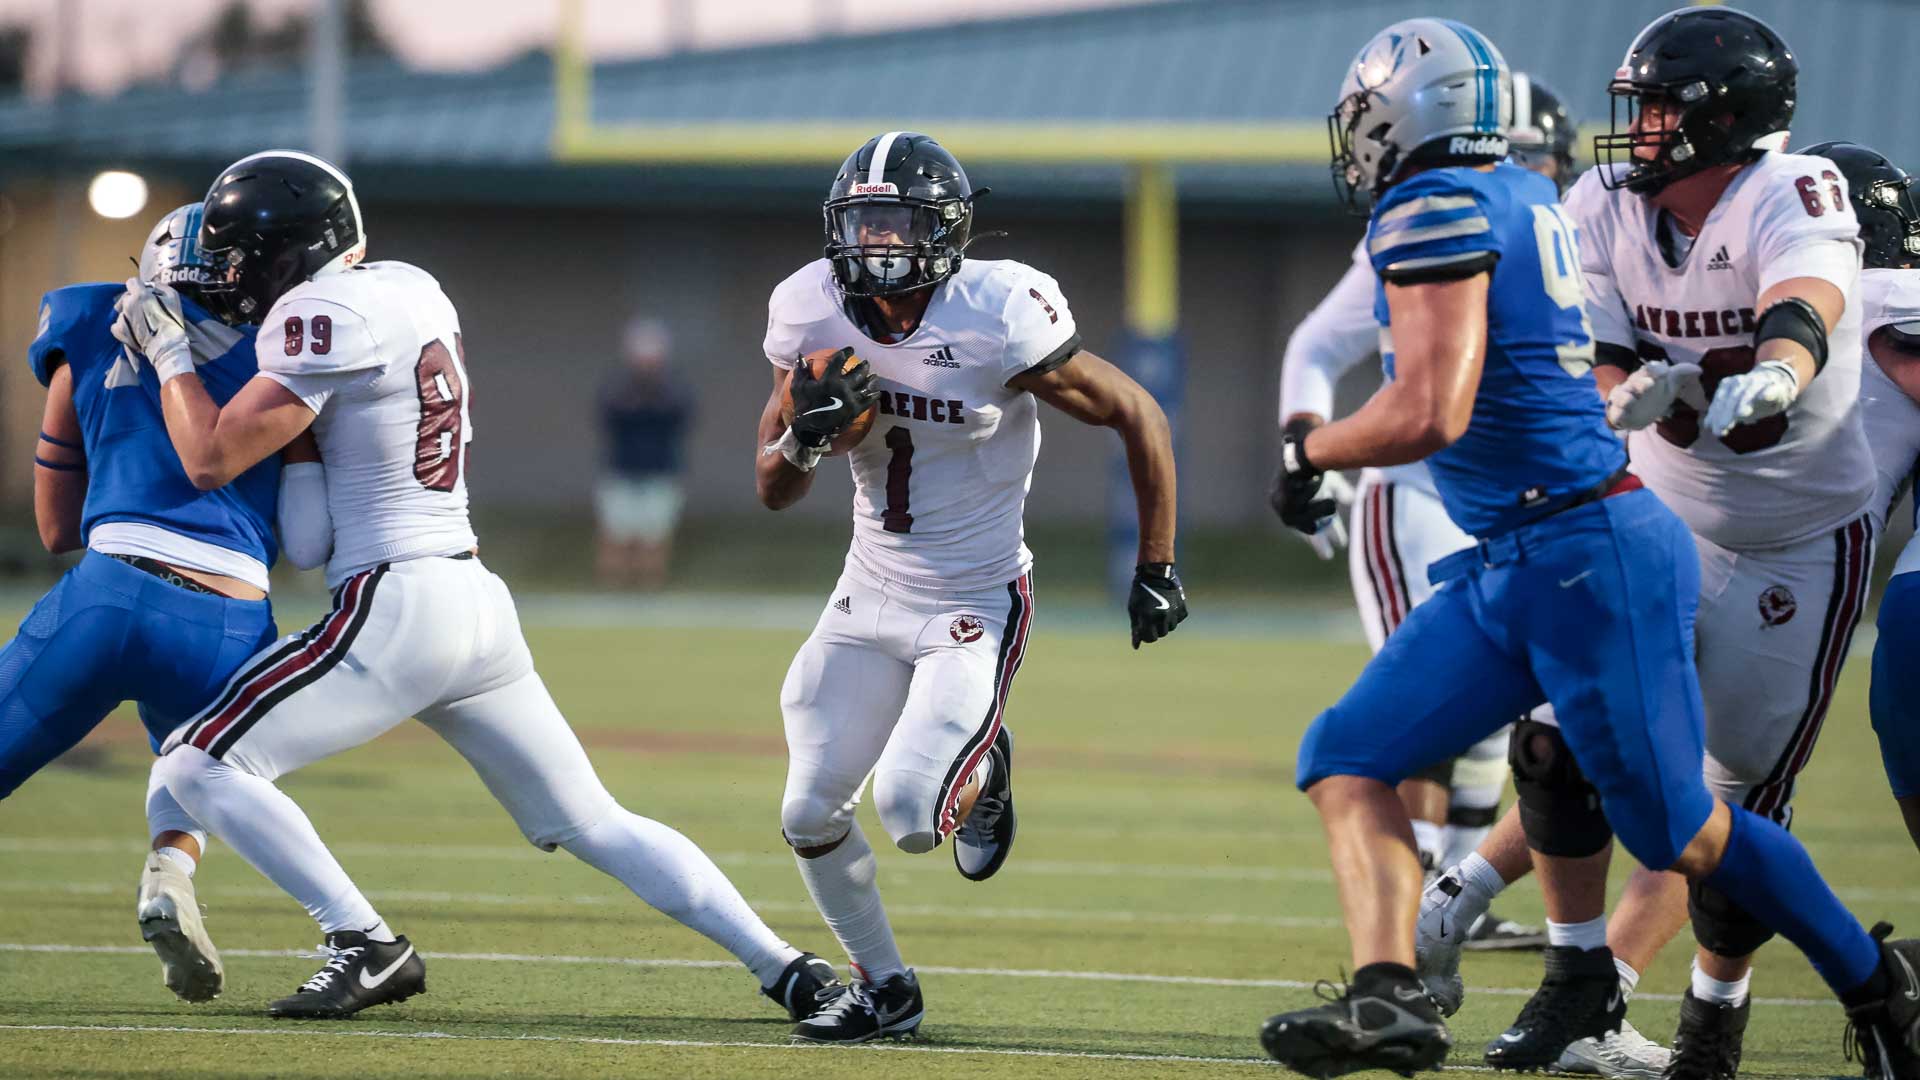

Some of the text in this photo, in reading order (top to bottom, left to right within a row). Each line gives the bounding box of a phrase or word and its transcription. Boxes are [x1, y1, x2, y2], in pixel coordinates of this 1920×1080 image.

[856, 184, 892, 193] Riddell
[284, 315, 332, 357] 89
[922, 357, 961, 369] adidas
[879, 390, 965, 425] RENCE
[881, 425, 914, 534] 1
